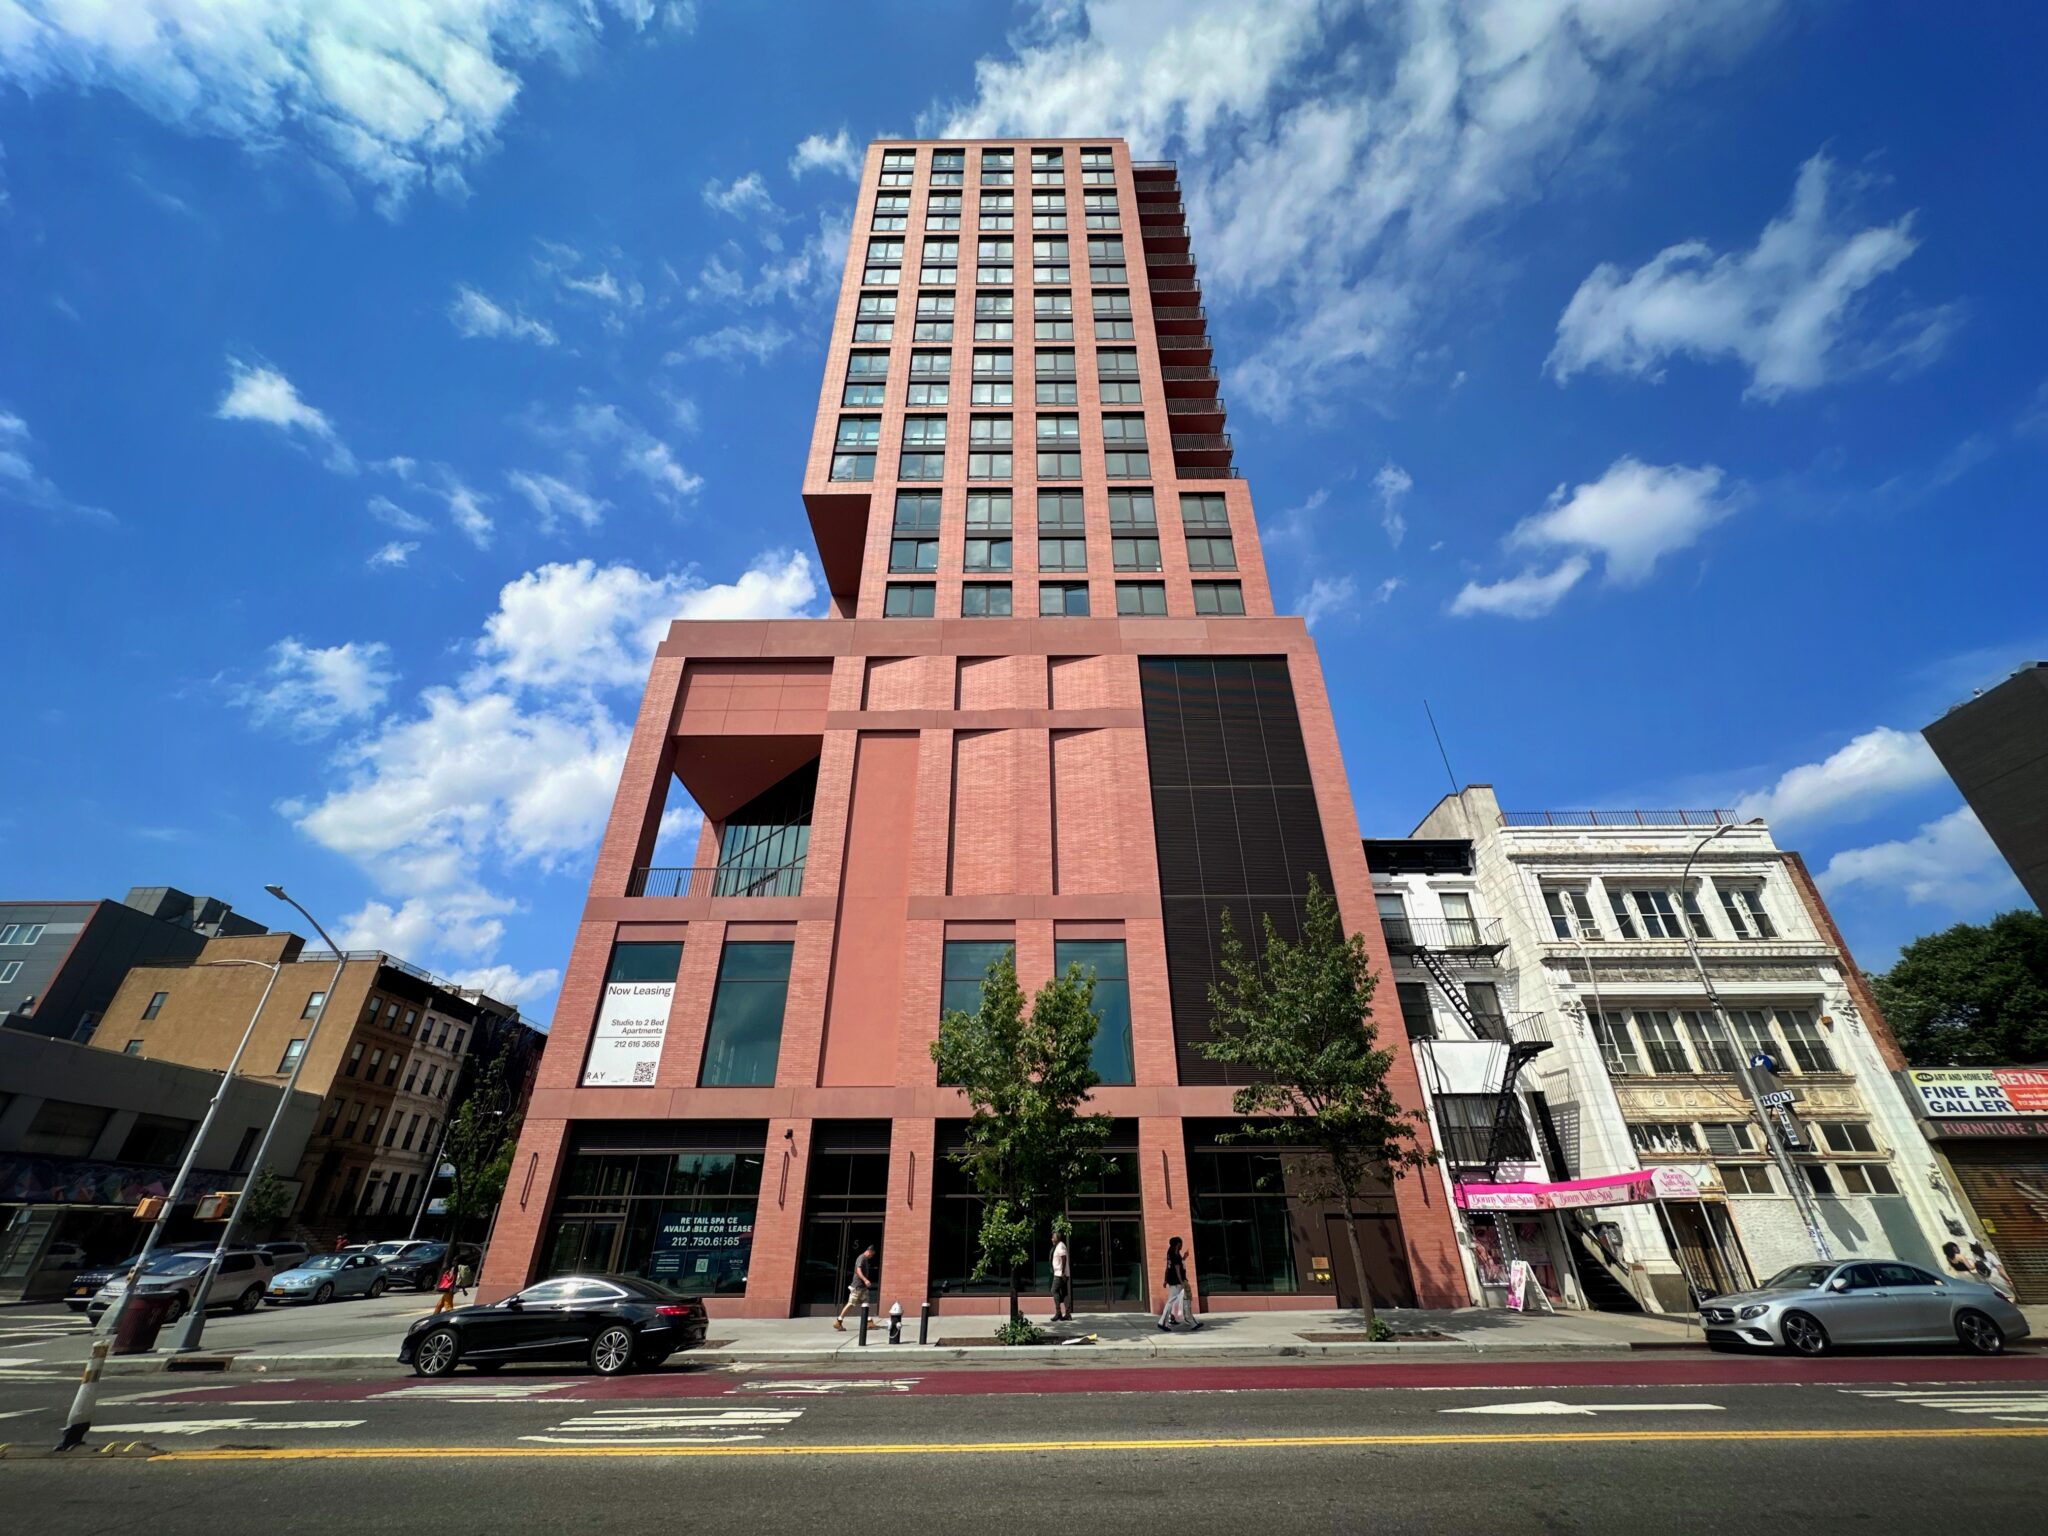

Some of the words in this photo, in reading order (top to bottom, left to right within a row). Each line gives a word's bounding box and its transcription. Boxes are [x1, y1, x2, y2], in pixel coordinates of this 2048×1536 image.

[608, 986, 631, 995] Now
[633, 986, 672, 997] Leasing
[621, 1027, 663, 1035] Apartments
[1934, 1073, 1948, 1081] ART
[1948, 1073, 1963, 1081] AND
[1962, 1073, 1983, 1081] HOME
[1997, 1073, 2048, 1086] RETAIL
[1920, 1086, 1970, 1098] FINE
[1974, 1086, 2006, 1098] AR
[1763, 1091, 1792, 1105] HOLY
[1942, 1122, 2028, 1135] FURNITURE
[663, 1225, 708, 1233] AVAILABLE
[708, 1225, 725, 1233] FOR
[728, 1225, 753, 1233] LEASE
